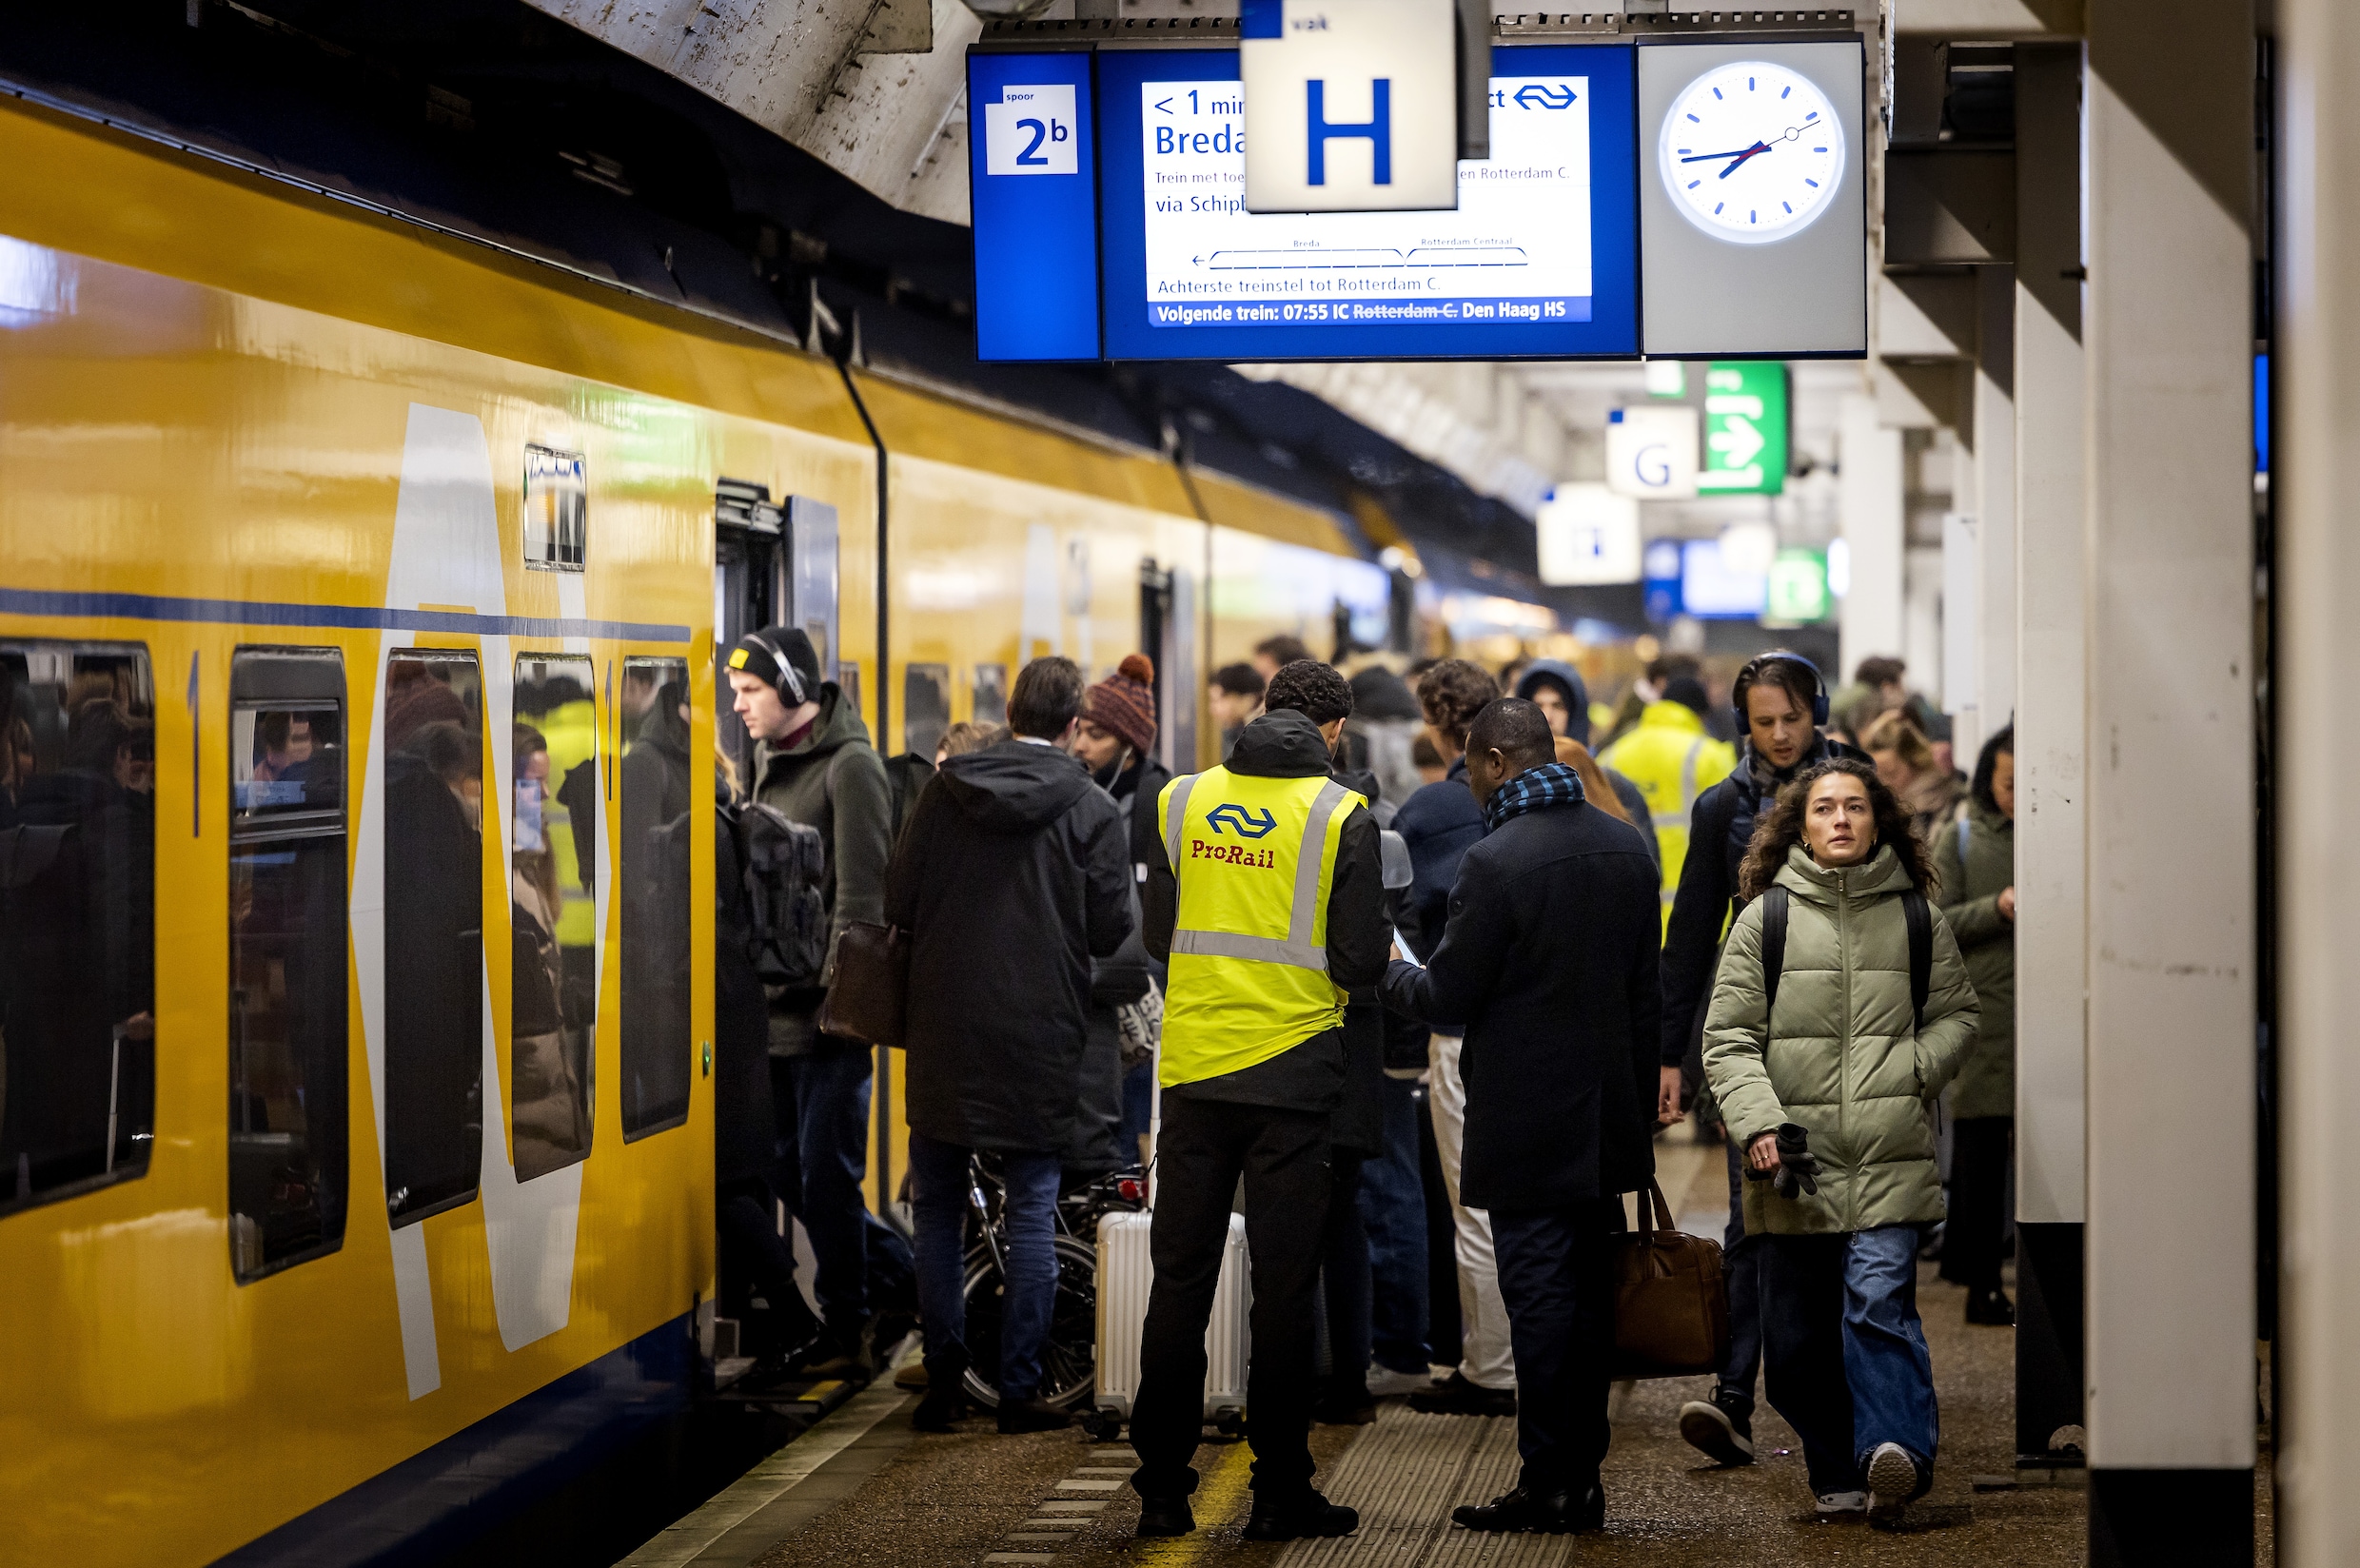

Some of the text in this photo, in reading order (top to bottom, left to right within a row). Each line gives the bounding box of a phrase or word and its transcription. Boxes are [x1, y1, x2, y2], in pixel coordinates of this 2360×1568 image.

[1291, 15, 1328, 31] vak
[1006, 93, 1034, 102] spoor
[1188, 89, 1198, 115] 1
[1307, 79, 1391, 186] H
[1155, 171, 1187, 184] Trein
[1192, 172, 1217, 184] met
[1460, 167, 1570, 179] en Rotterdam C.
[1156, 196, 1183, 212] via
[1421, 237, 1513, 246] Rotterdam Centraal
[1158, 277, 1441, 294] Achterste treinstel tot Rotterdam C.
[1157, 301, 1566, 325] Volgende trein: 07:55 IC Rotterdam C. Den Haag HS
[1635, 443, 1670, 487] G
[1191, 839, 1274, 869] ProRail
